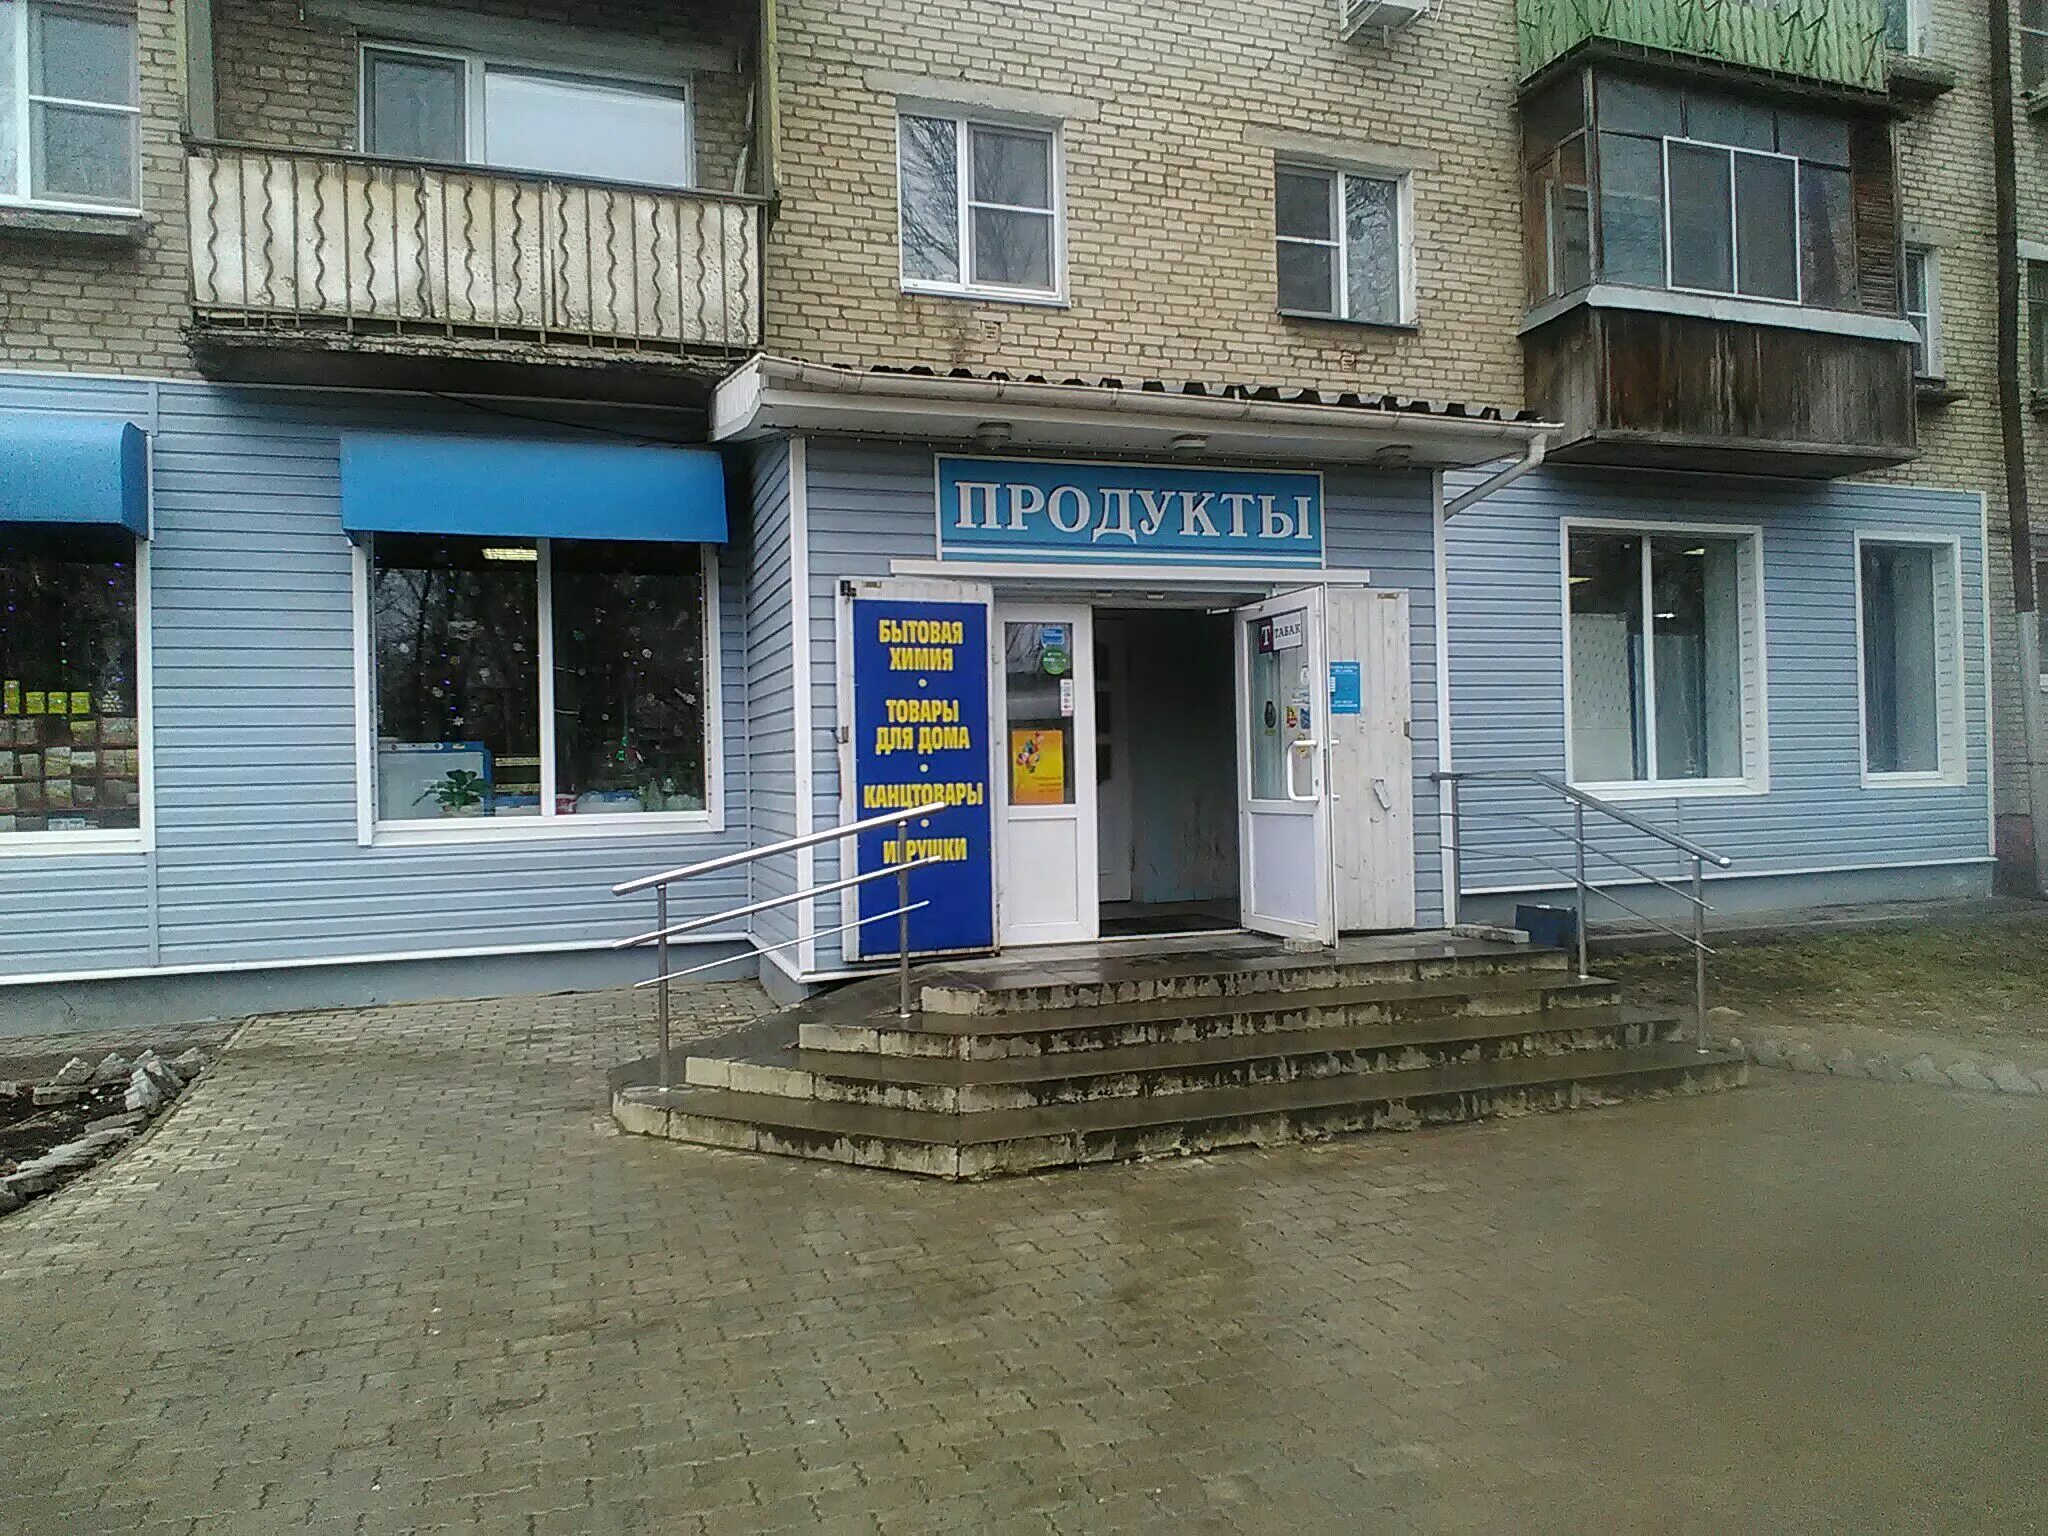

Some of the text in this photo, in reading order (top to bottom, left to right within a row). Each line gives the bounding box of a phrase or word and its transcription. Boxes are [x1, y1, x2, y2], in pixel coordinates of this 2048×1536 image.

[954, 481, 1313, 544] ПРОДУКТЫ
[879, 619, 963, 644] БЫТОВАЯ
[1261, 625, 1271, 646] Т
[1274, 623, 1301, 639] ТАБАК
[889, 647, 953, 671] ХИМИЯ
[886, 699, 959, 723] ТОВАРЫ
[875, 727, 970, 755] ДЛЯ ДОМА
[864, 782, 983, 809] КАНЦТОВАРЫ
[883, 838, 967, 864] ИРУШКИ
